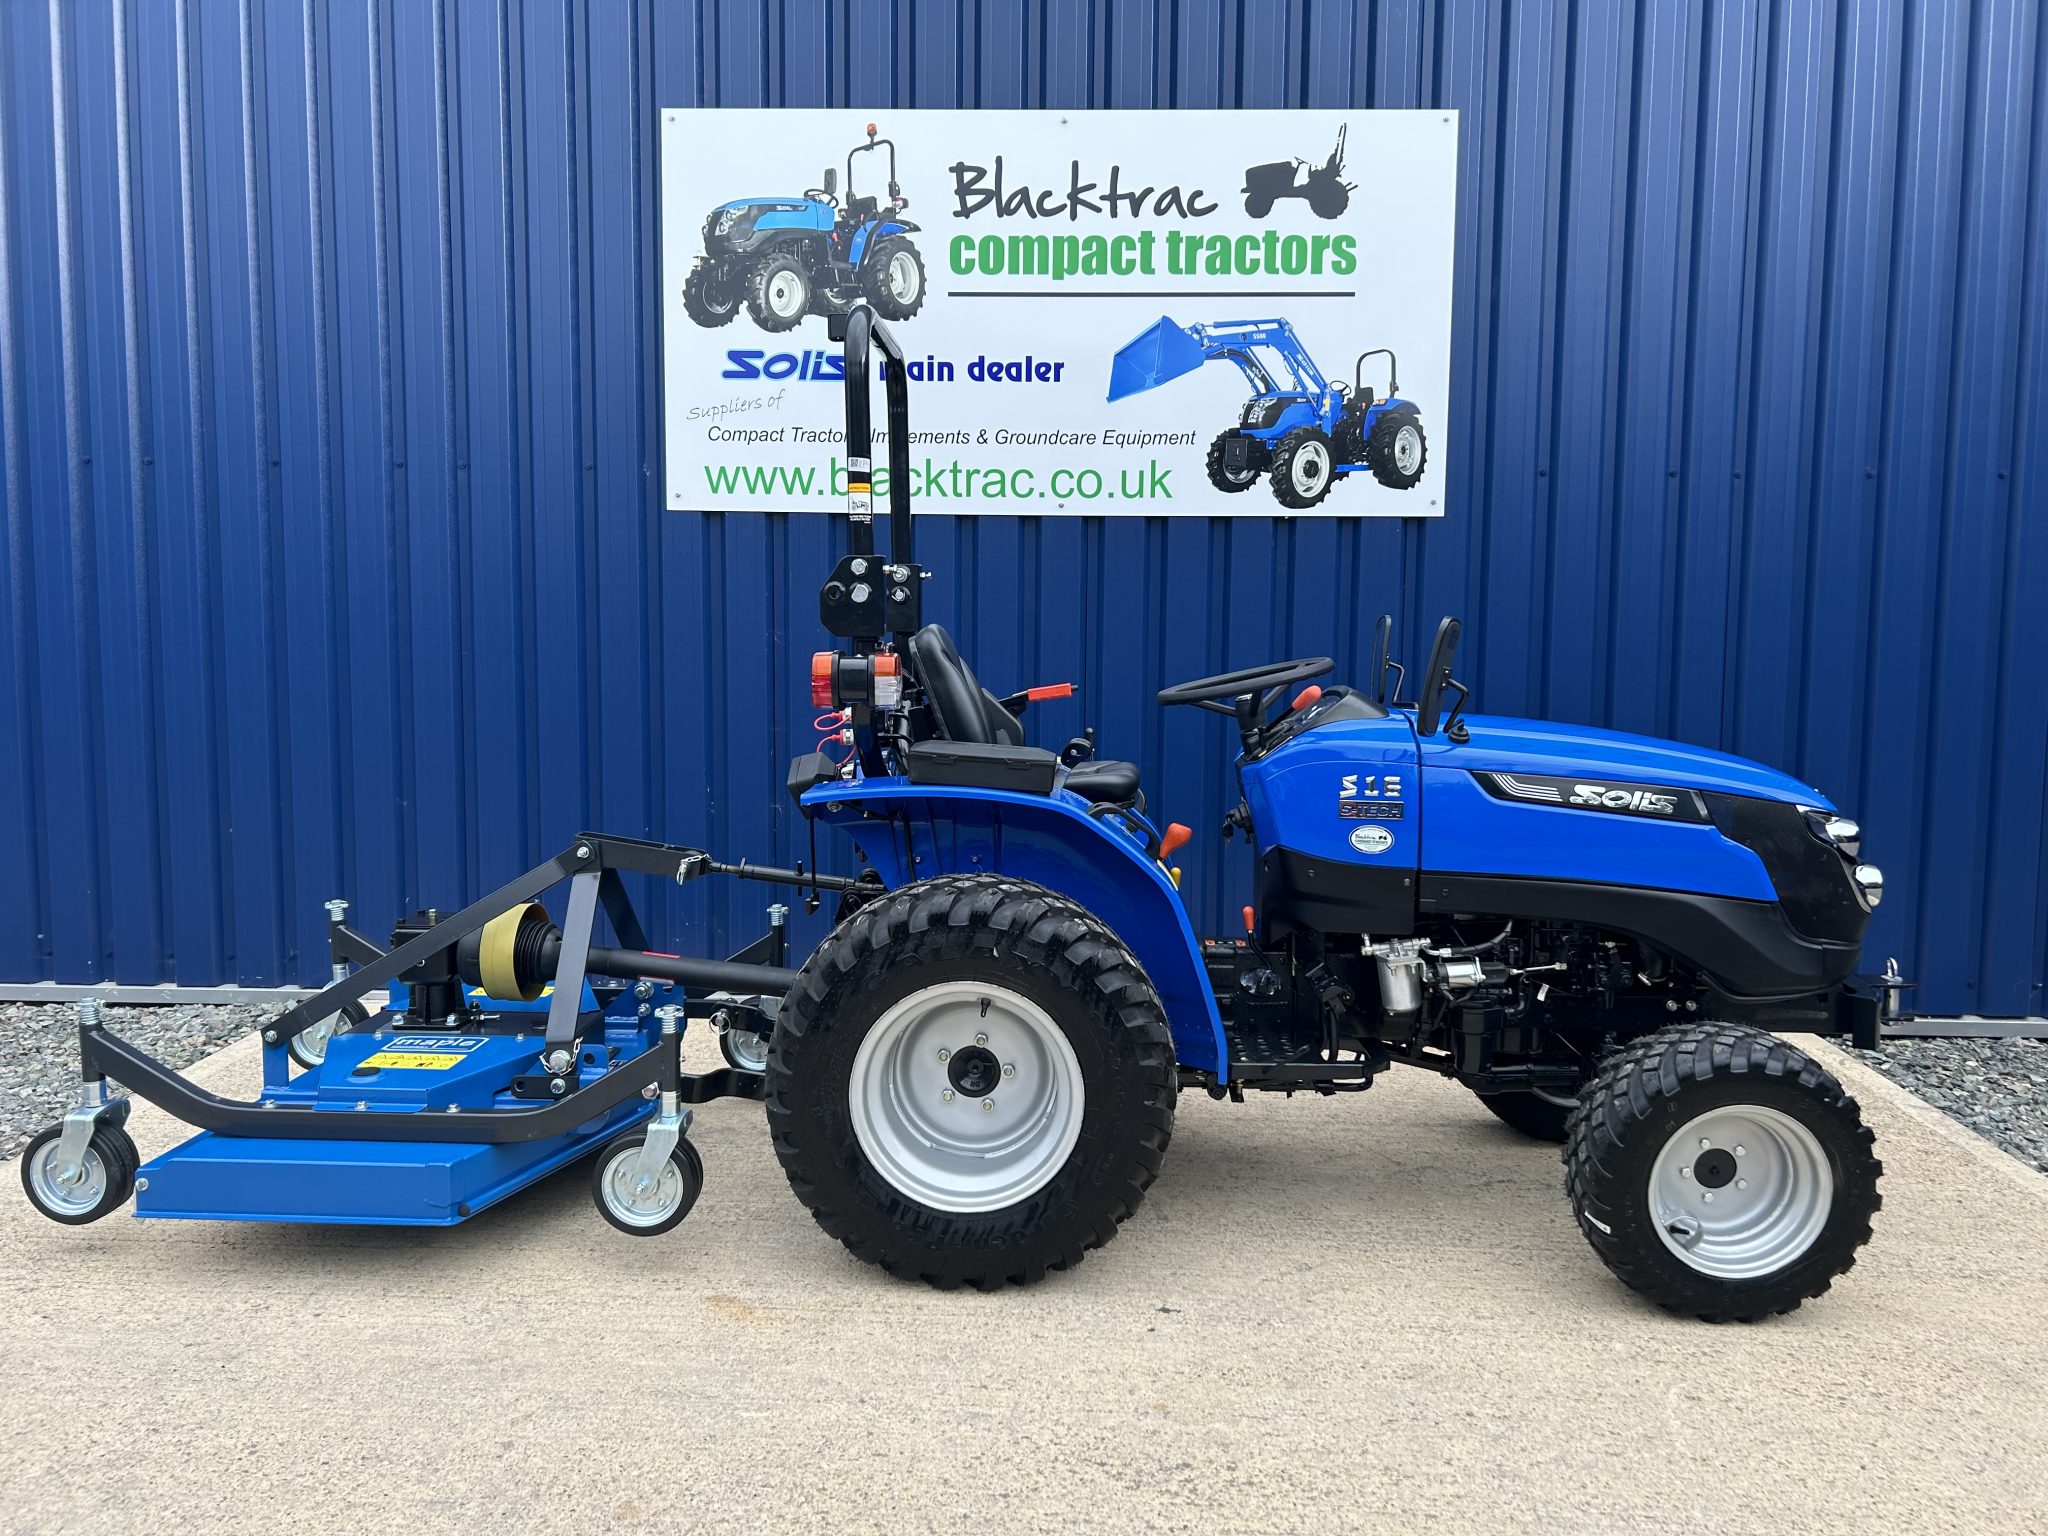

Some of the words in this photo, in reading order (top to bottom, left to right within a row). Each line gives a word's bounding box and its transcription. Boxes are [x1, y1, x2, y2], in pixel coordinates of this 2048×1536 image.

[948, 155, 1218, 222] Blacktrac
[949, 230, 1156, 281] compact
[1166, 230, 1357, 276] tractors
[879, 355, 954, 382] ain
[967, 355, 1065, 383] dealer
[686, 397, 762, 423] Suppliers
[767, 388, 786, 410] of
[707, 425, 785, 445] Compact
[791, 427, 848, 443] Tractor
[870, 428, 971, 445] Imements
[976, 429, 989, 445] &
[995, 429, 1097, 446] Groundcare
[1102, 429, 1197, 449] Equipment
[704, 457, 1174, 499] www.backtrac.co.uk
[1340, 803, 1403, 817] S-TECH
